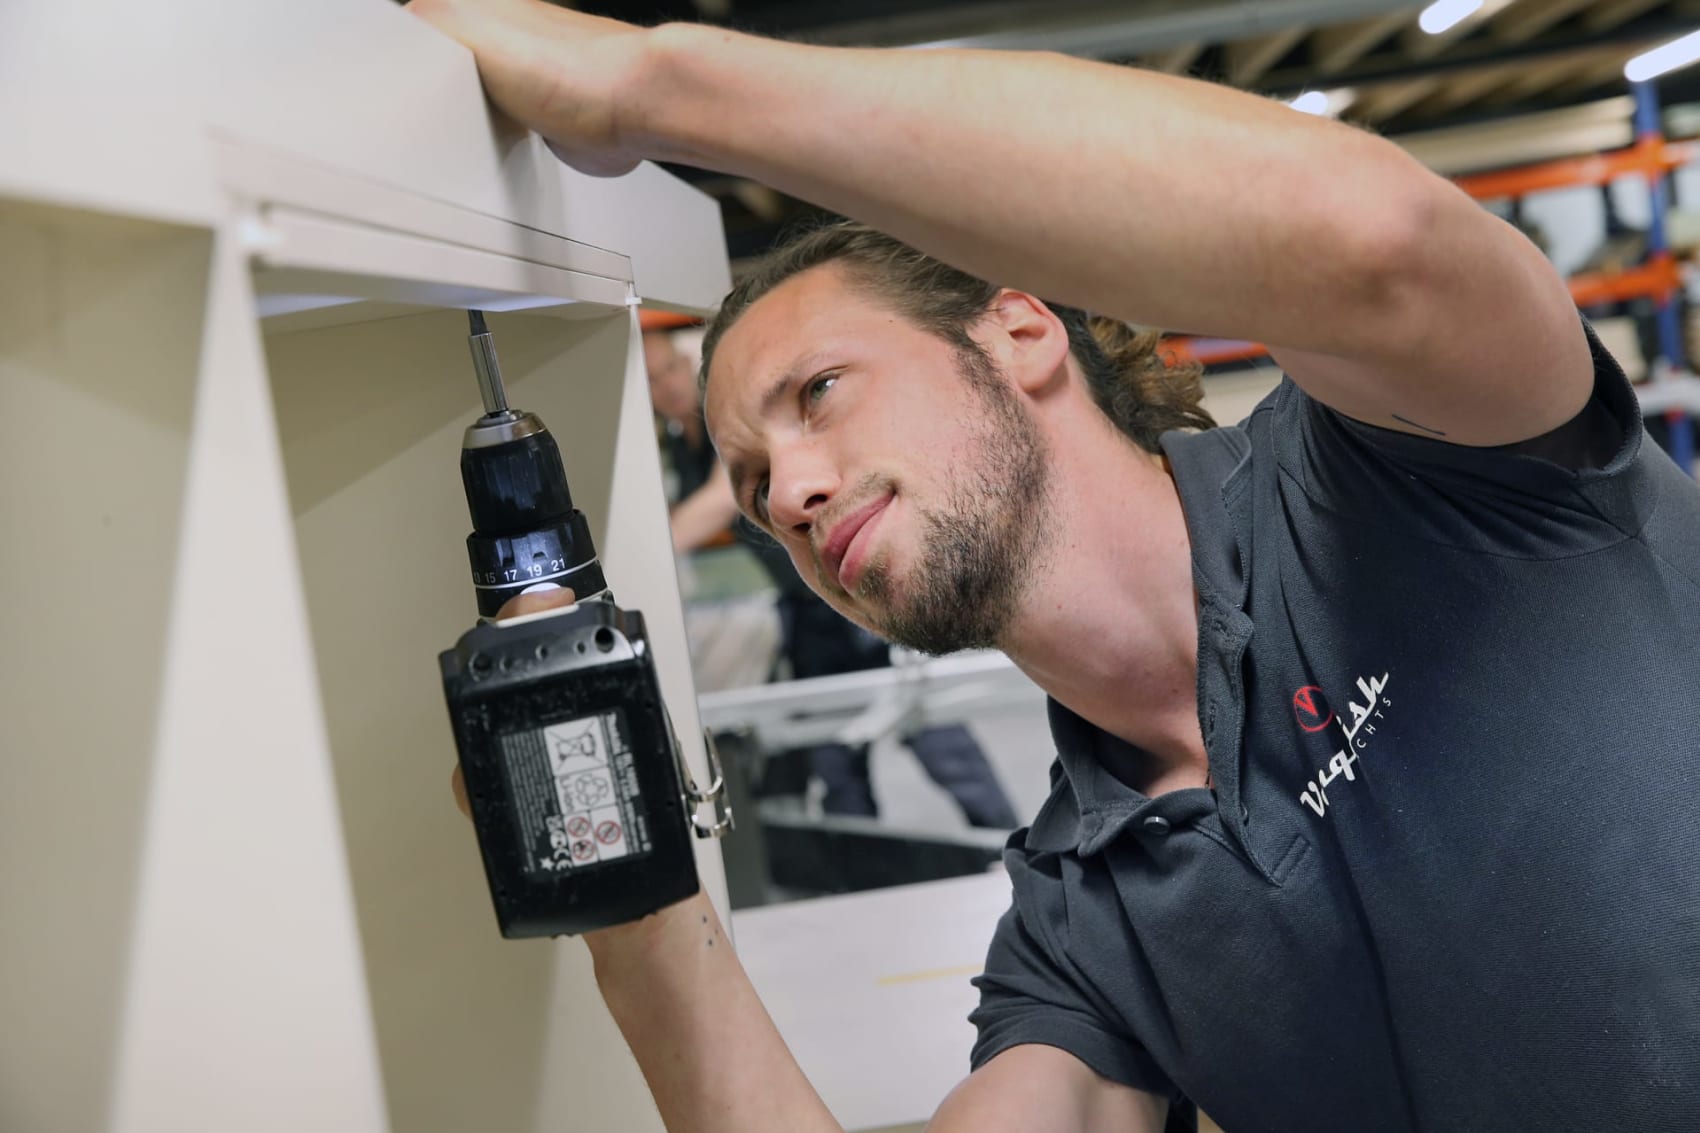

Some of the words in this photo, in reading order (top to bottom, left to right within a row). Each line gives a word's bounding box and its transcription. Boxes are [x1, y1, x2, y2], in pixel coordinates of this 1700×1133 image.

[485, 572, 496, 584] 15
[504, 569, 518, 582] 17
[527, 565, 543, 577] 19
[551, 559, 566, 572] 21
[1356, 697, 1391, 749] CHTS
